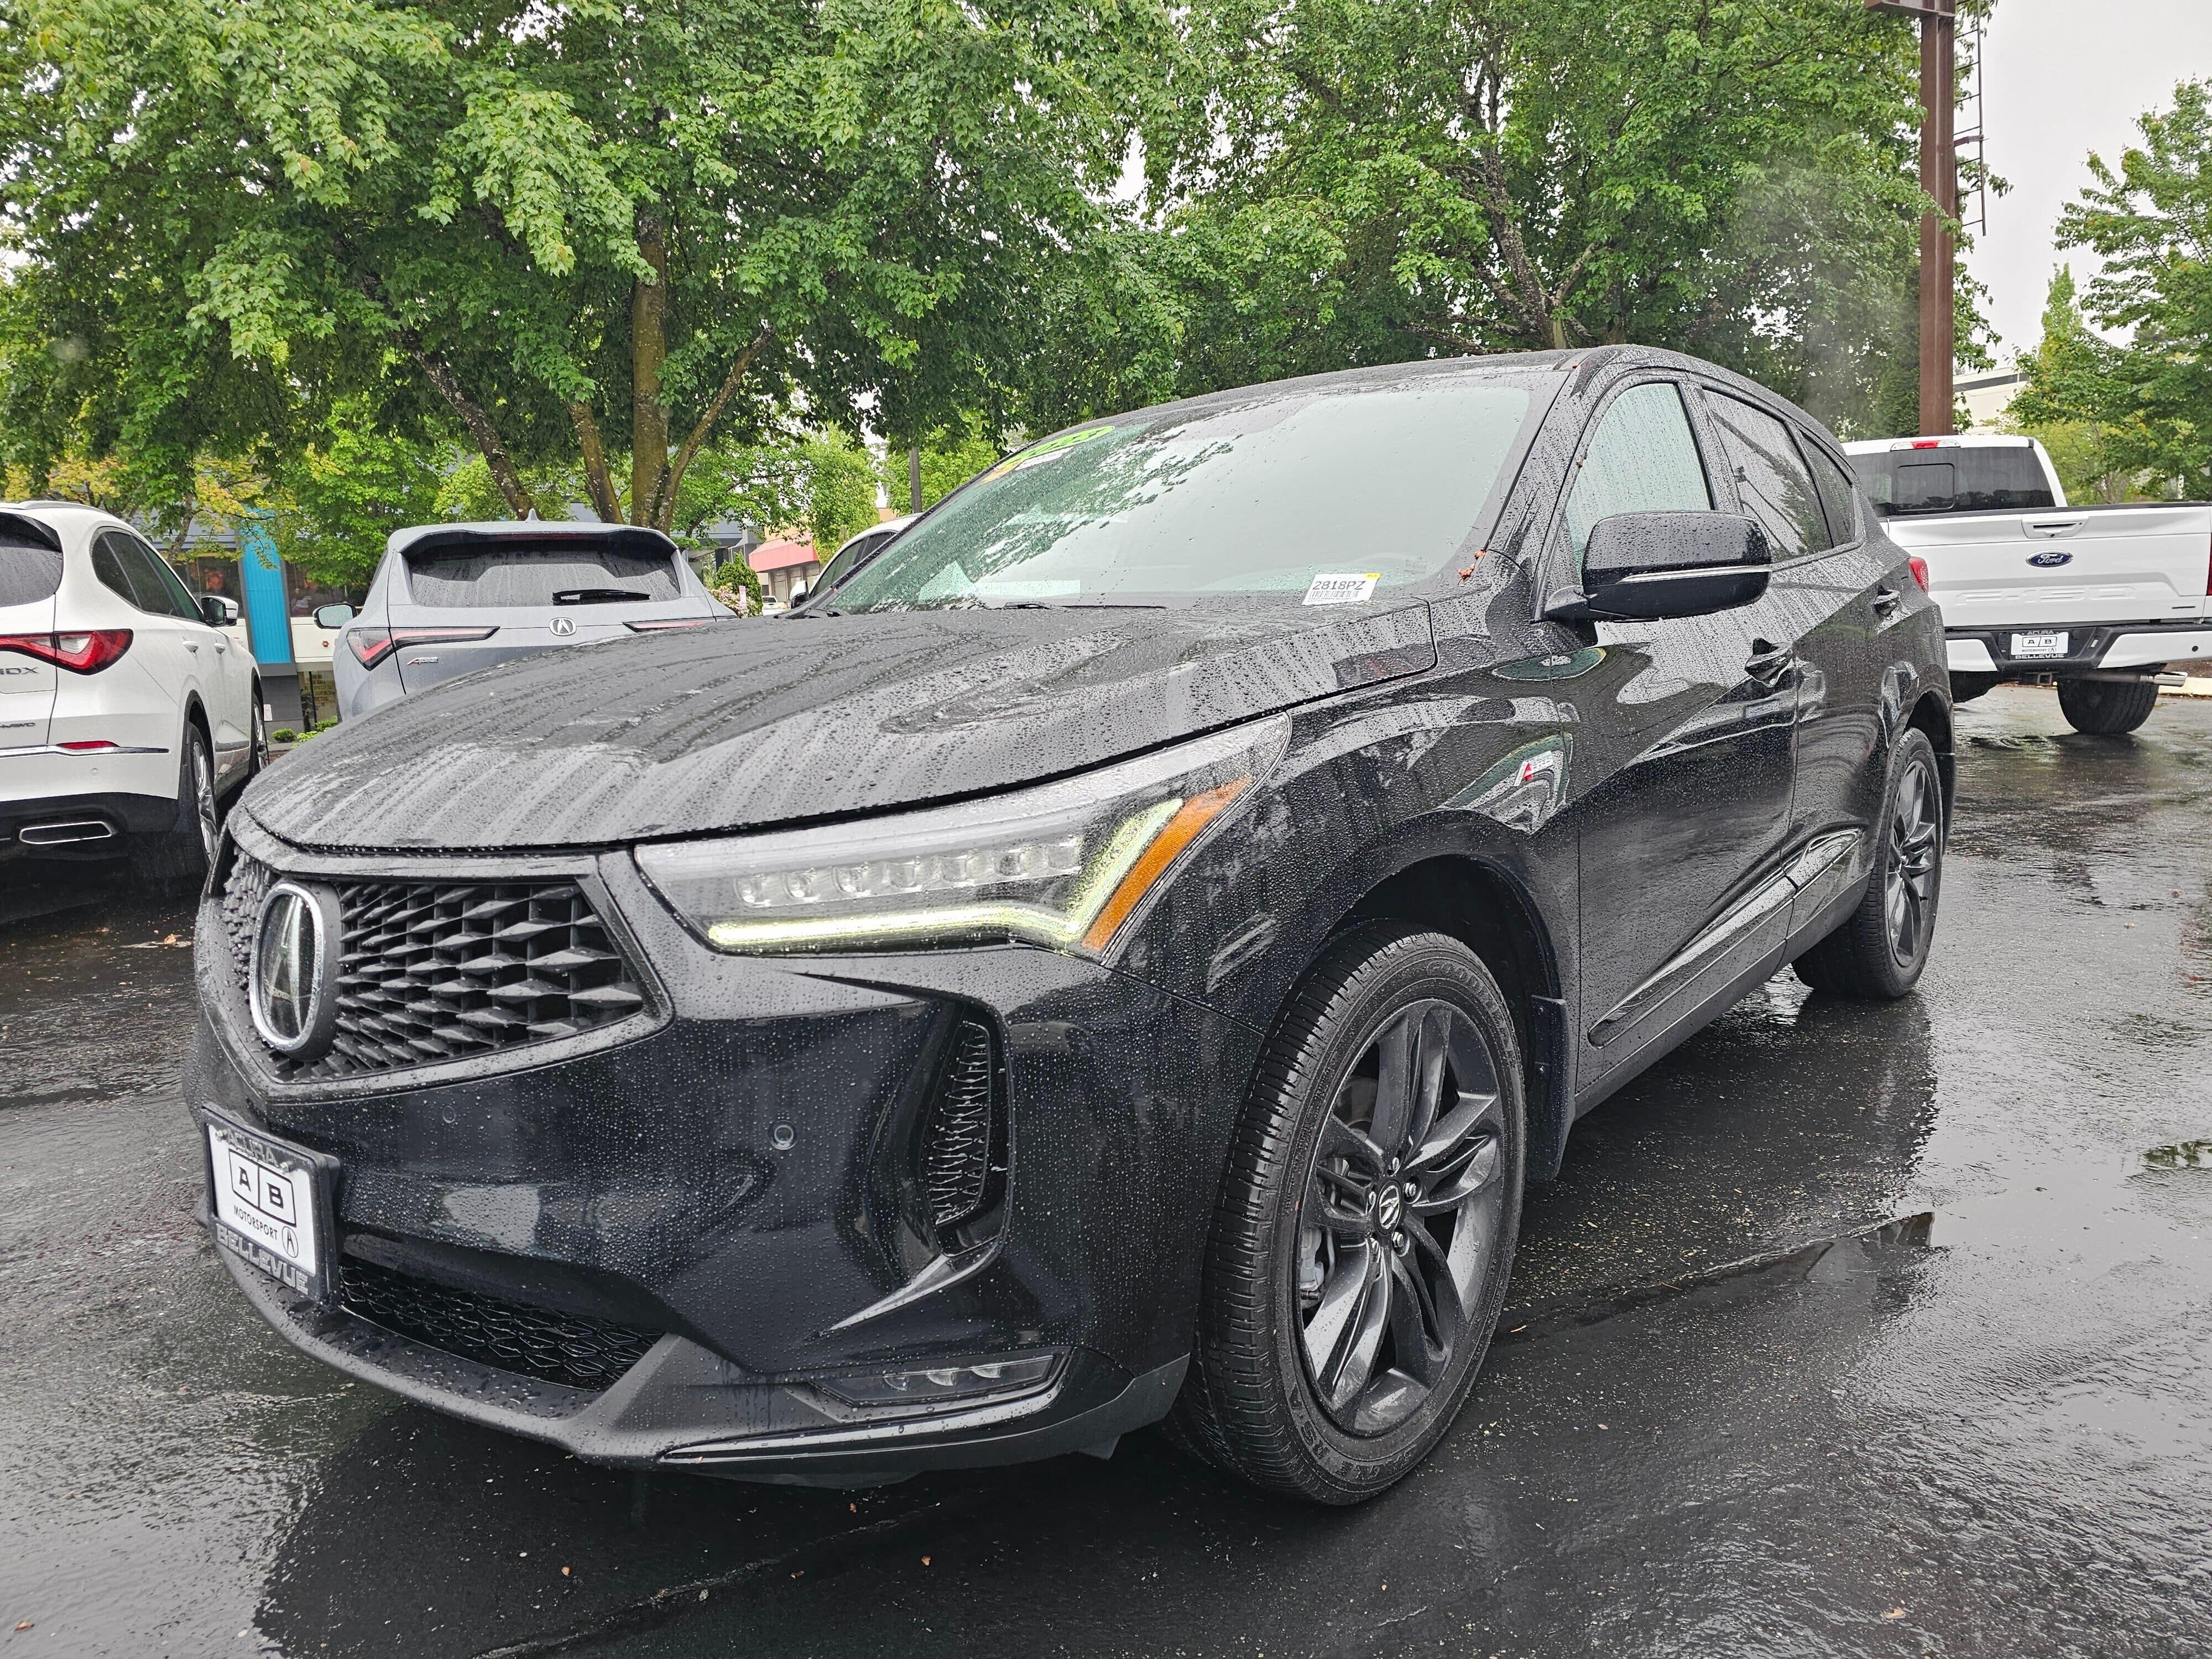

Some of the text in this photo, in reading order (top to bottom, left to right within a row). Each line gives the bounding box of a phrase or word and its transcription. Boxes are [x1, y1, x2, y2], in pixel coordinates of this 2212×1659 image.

[2037, 553, 2063, 565] Ford
[1312, 580, 1366, 591] 2818PZ
[1955, 586, 2136, 606] F-150
[0, 667, 39, 675] DX
[226, 1128, 279, 1167] ACURA
[239, 1166, 284, 1209] A B
[233, 1204, 278, 1241] MOTORSPORT
[216, 1223, 309, 1295] BELLEVUE
